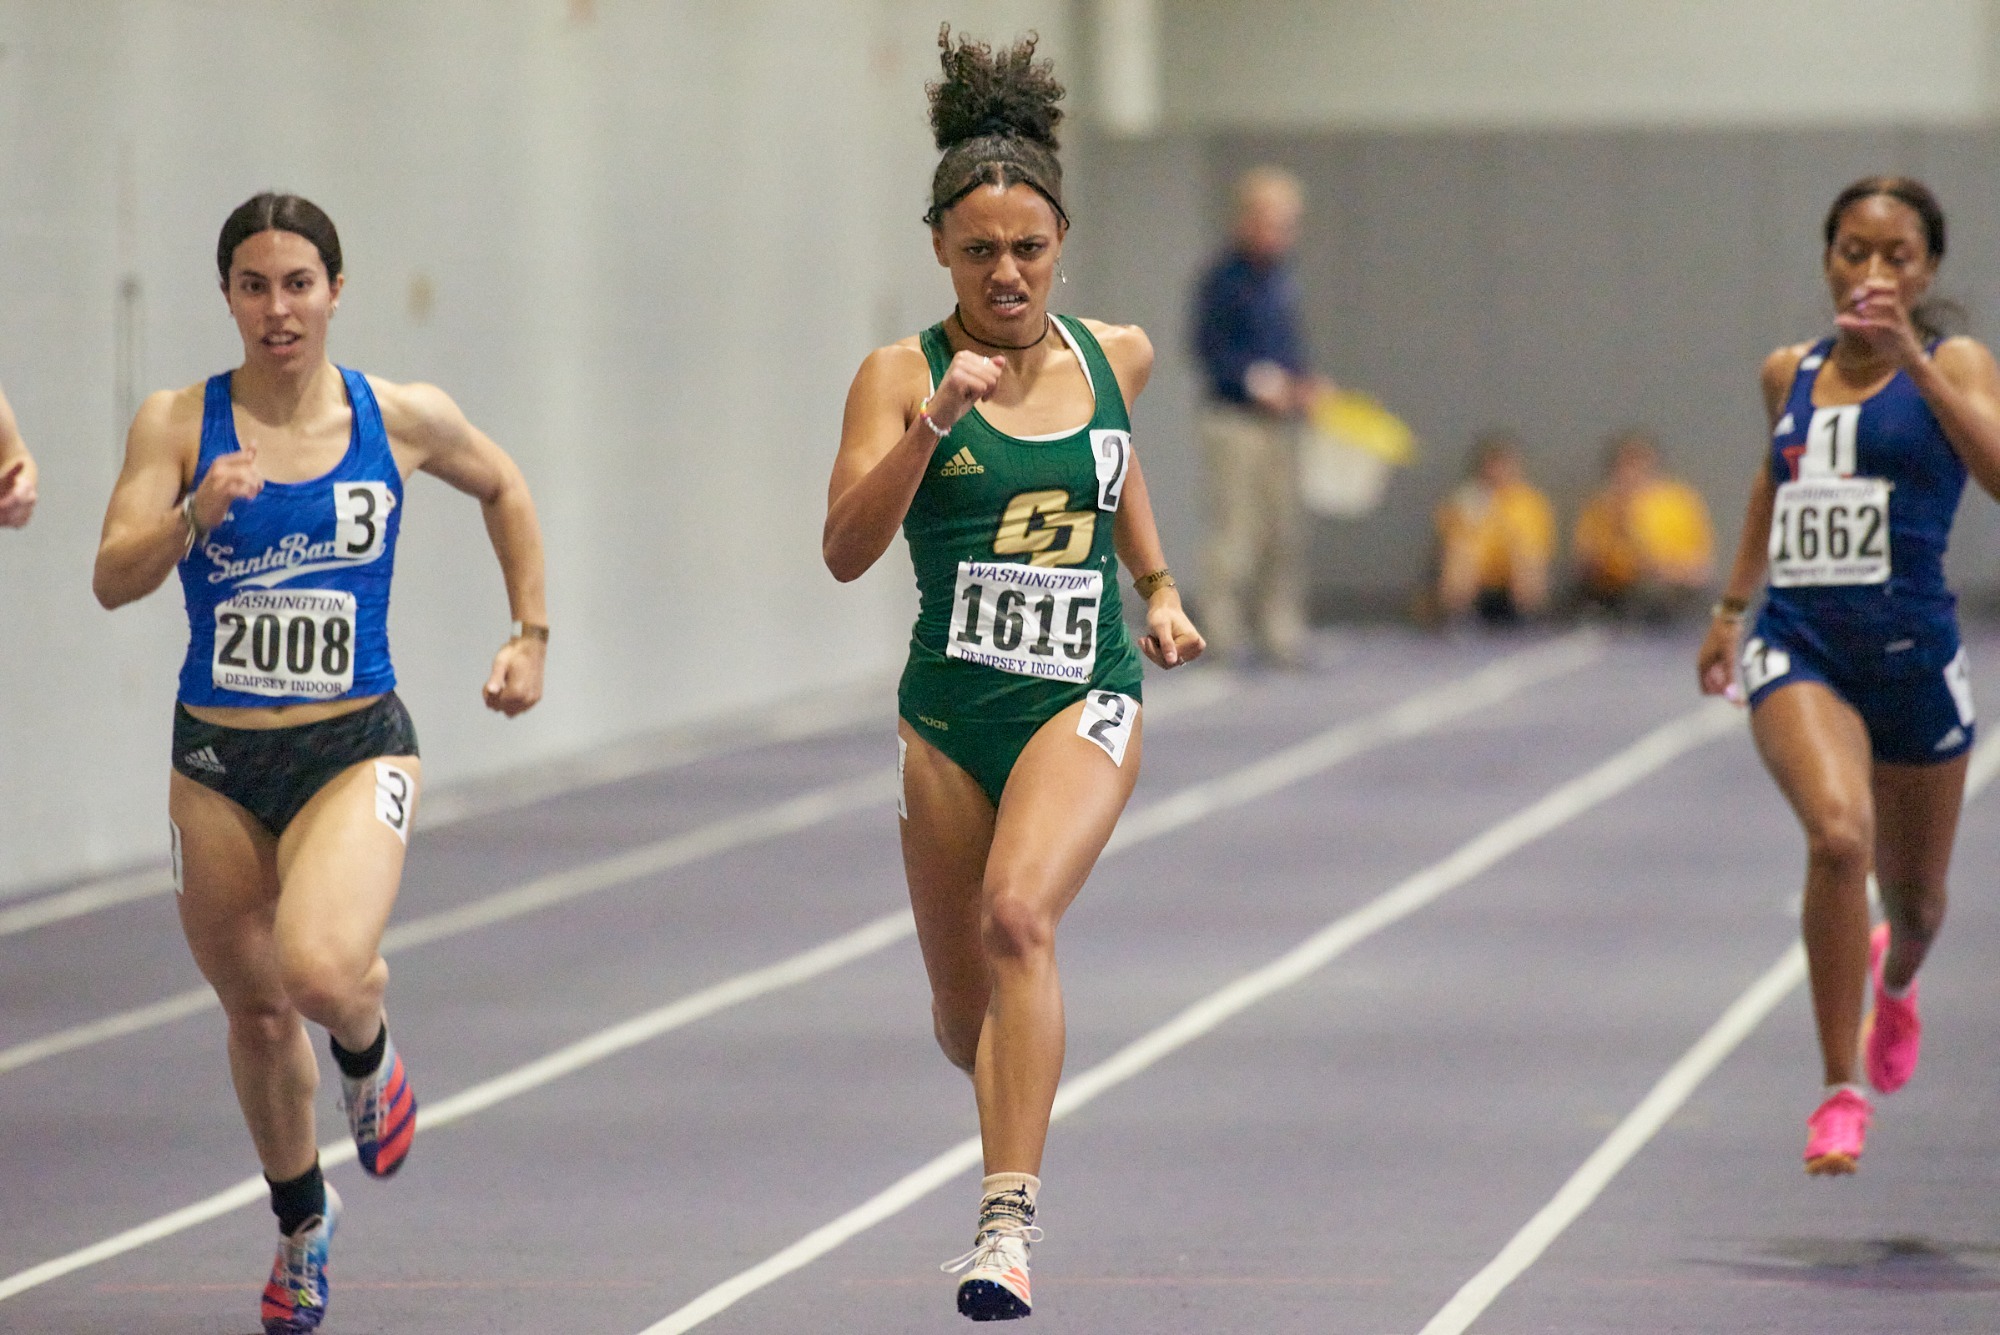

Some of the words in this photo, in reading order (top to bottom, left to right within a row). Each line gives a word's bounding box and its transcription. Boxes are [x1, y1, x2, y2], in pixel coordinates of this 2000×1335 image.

[1824, 413, 1841, 469] 1
[941, 464, 985, 476] adidas
[1101, 435, 1124, 506] 2
[347, 487, 376, 554] 3
[1777, 506, 1882, 561] 1662
[226, 594, 345, 611] WASHINGTON
[968, 564, 1094, 590] WASHINGTON
[218, 613, 350, 675] 2008
[957, 584, 1096, 660] 1615
[225, 673, 286, 689] DEMPSEY
[291, 679, 343, 693] INDOOR
[961, 650, 1027, 671] DEMPSEY
[1031, 662, 1083, 678] INDOOR
[1088, 693, 1125, 753] 2
[386, 771, 407, 829] 3
